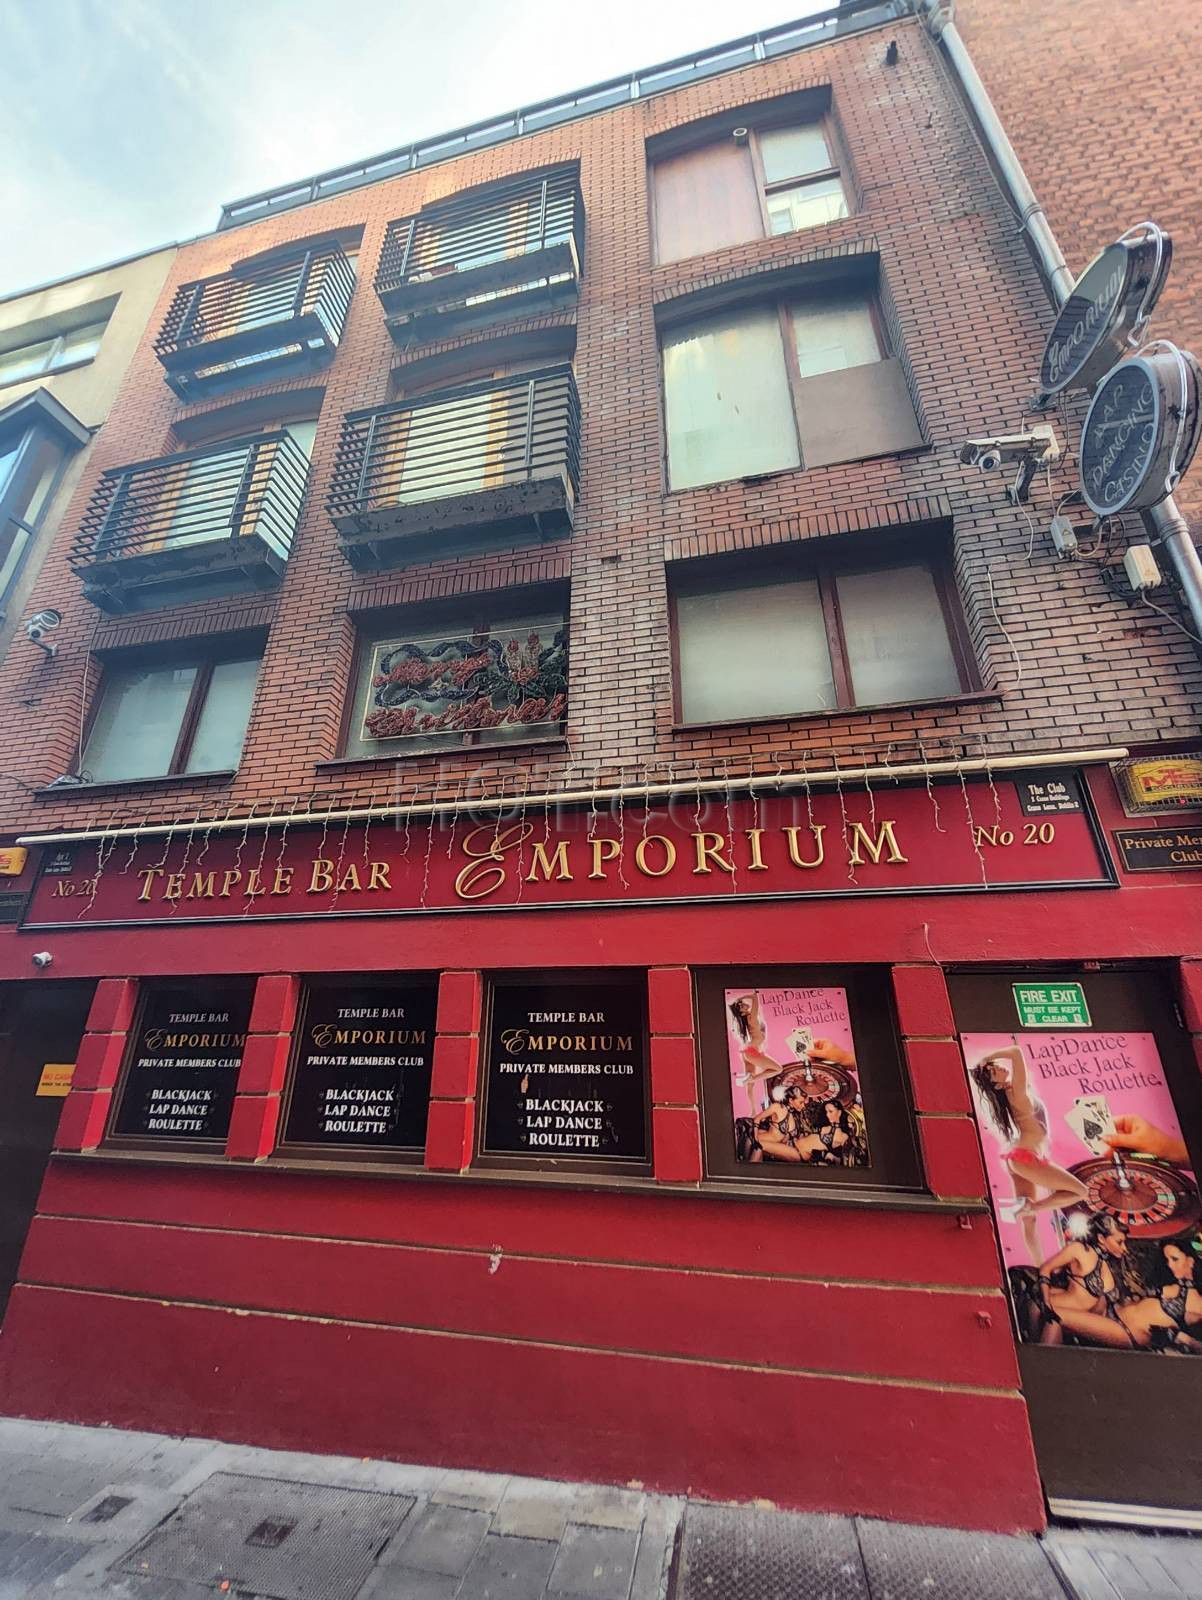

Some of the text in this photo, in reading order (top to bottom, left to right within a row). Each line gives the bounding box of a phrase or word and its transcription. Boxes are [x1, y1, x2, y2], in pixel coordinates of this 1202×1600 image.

[1103, 422, 1154, 503] CASINO
[1027, 782, 1066, 796] The Club
[975, 822, 1055, 847] No 20
[1124, 838, 1175, 850] Private
[137, 820, 909, 902] TEMPLE BAR EMPORIUM
[51, 880, 75, 896] No
[761, 988, 825, 1006] LapDance
[1019, 990, 1078, 1003] FIRE EXIT
[337, 1007, 405, 1018] TEMPLE BAR
[772, 999, 833, 1017] Black Jack
[1023, 1006, 1046, 1014] MUST
[1060, 1006, 1082, 1014] KEPT
[169, 1012, 230, 1024] TEMPLE BAR
[528, 1012, 605, 1023] TEMPLE BAR
[795, 1010, 846, 1027] Roulette
[1041, 1014, 1069, 1023] CLEAR
[144, 1028, 246, 1052] EMPORIUM
[311, 1023, 427, 1049] EMPORIUM
[500, 1028, 633, 1056] EMPORIUM
[1026, 1034, 1129, 1063] LapDance
[137, 1058, 242, 1068] PRIVATE MEMBERS CLUB
[306, 1055, 424, 1067] PRIVATE MEMBERS CLUB
[1038, 1052, 1136, 1080] Black Jack
[499, 1063, 634, 1075] PRIVATE MEMBERS CLUB
[1078, 1072, 1162, 1096] Roulette
[151, 1089, 213, 1102] BLACKJACK
[325, 1088, 395, 1103] BLACKJACK
[149, 1103, 209, 1116] LAP DANCE
[324, 1104, 392, 1117] LAP DANCE
[525, 1098, 605, 1114] BLACKJACK
[148, 1118, 203, 1131] ROULETTE
[324, 1119, 387, 1134] ROULETTE
[526, 1115, 603, 1130] LAP DANCE
[528, 1132, 600, 1148] ROULETTE
